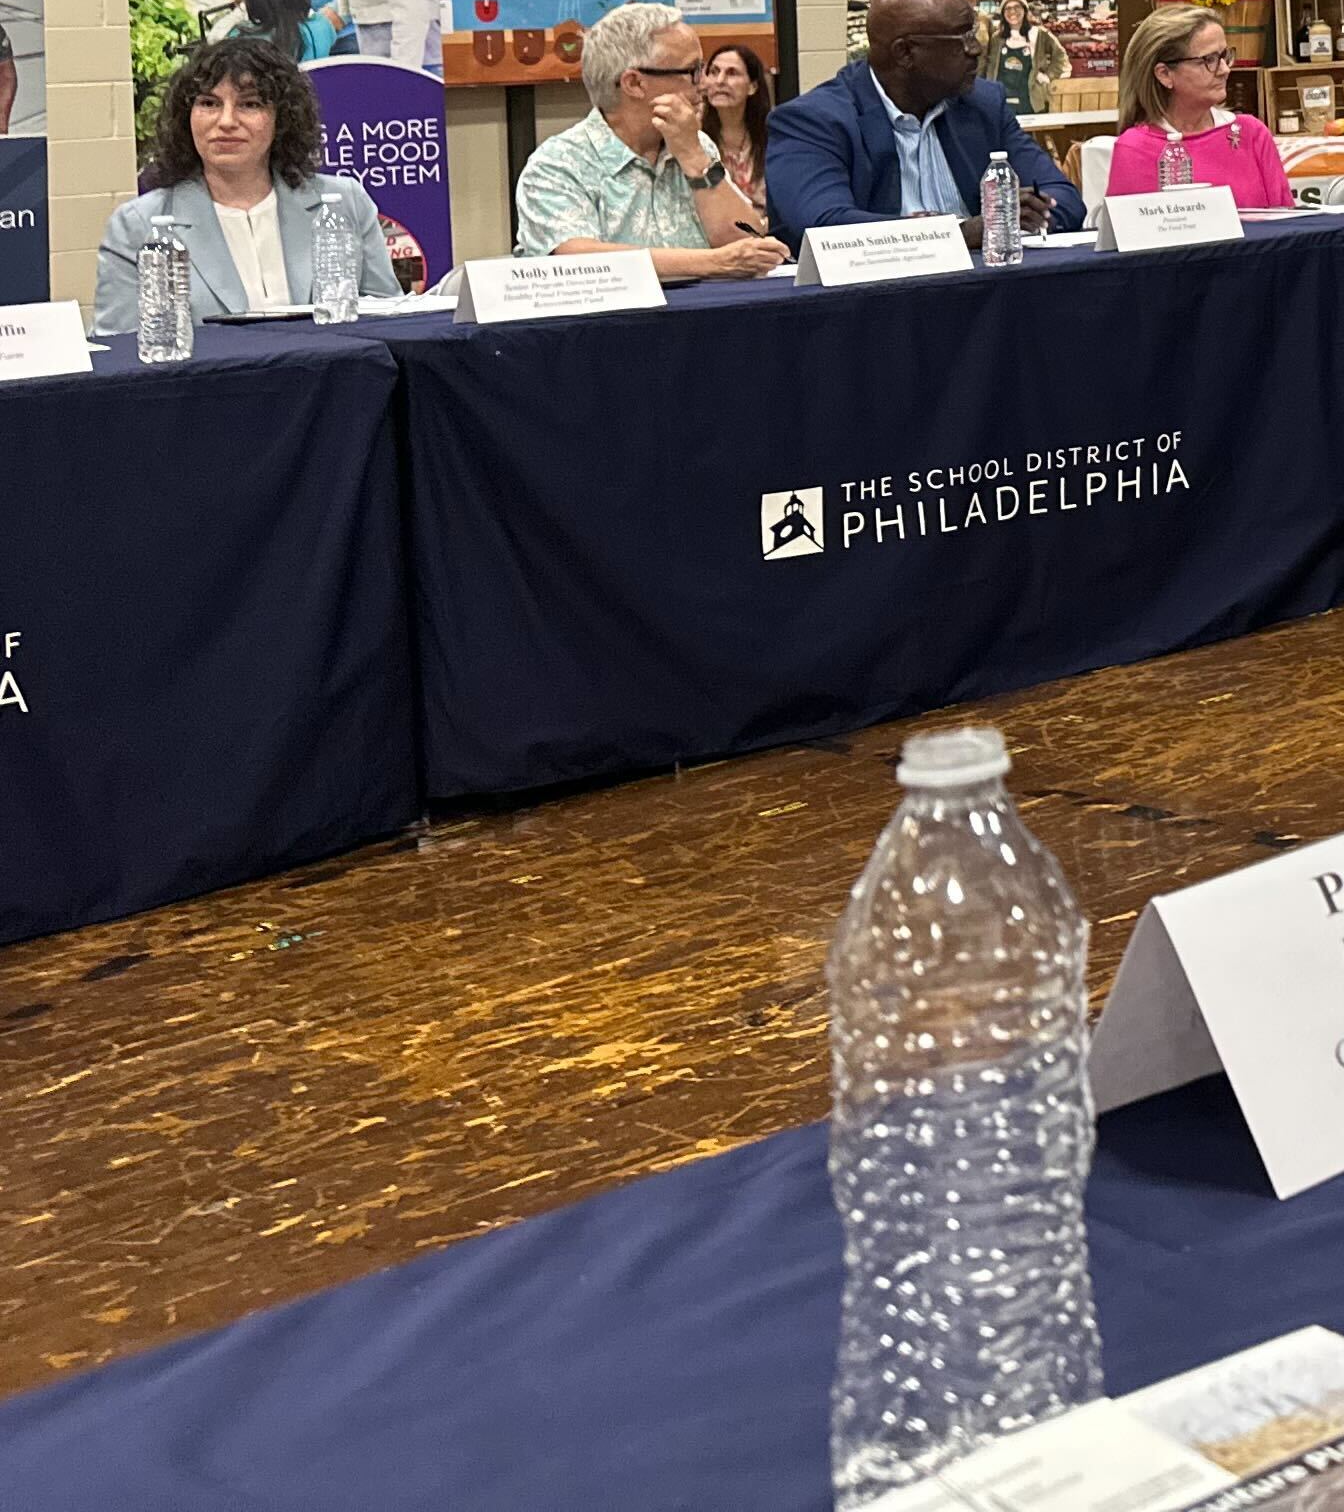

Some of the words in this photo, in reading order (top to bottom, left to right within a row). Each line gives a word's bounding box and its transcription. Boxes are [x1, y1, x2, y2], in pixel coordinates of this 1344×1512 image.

[336, 122, 354, 143] A
[362, 117, 439, 142] MORE
[364, 140, 440, 164] FOOD
[336, 163, 441, 187] SYSTEM
[1138, 205, 1166, 217] Mark
[1167, 201, 1207, 214] Edwards
[821, 239, 865, 252] Hannah
[866, 230, 952, 247] Smith-Brubaker
[511, 265, 549, 281] Molly
[552, 263, 612, 278] Hartman
[841, 475, 894, 503] THE
[907, 457, 1015, 493] SCHOOL
[1026, 438, 1146, 473] DISTRICT
[1156, 430, 1183, 453] OF
[842, 458, 1191, 549] PHILADELPHIA
